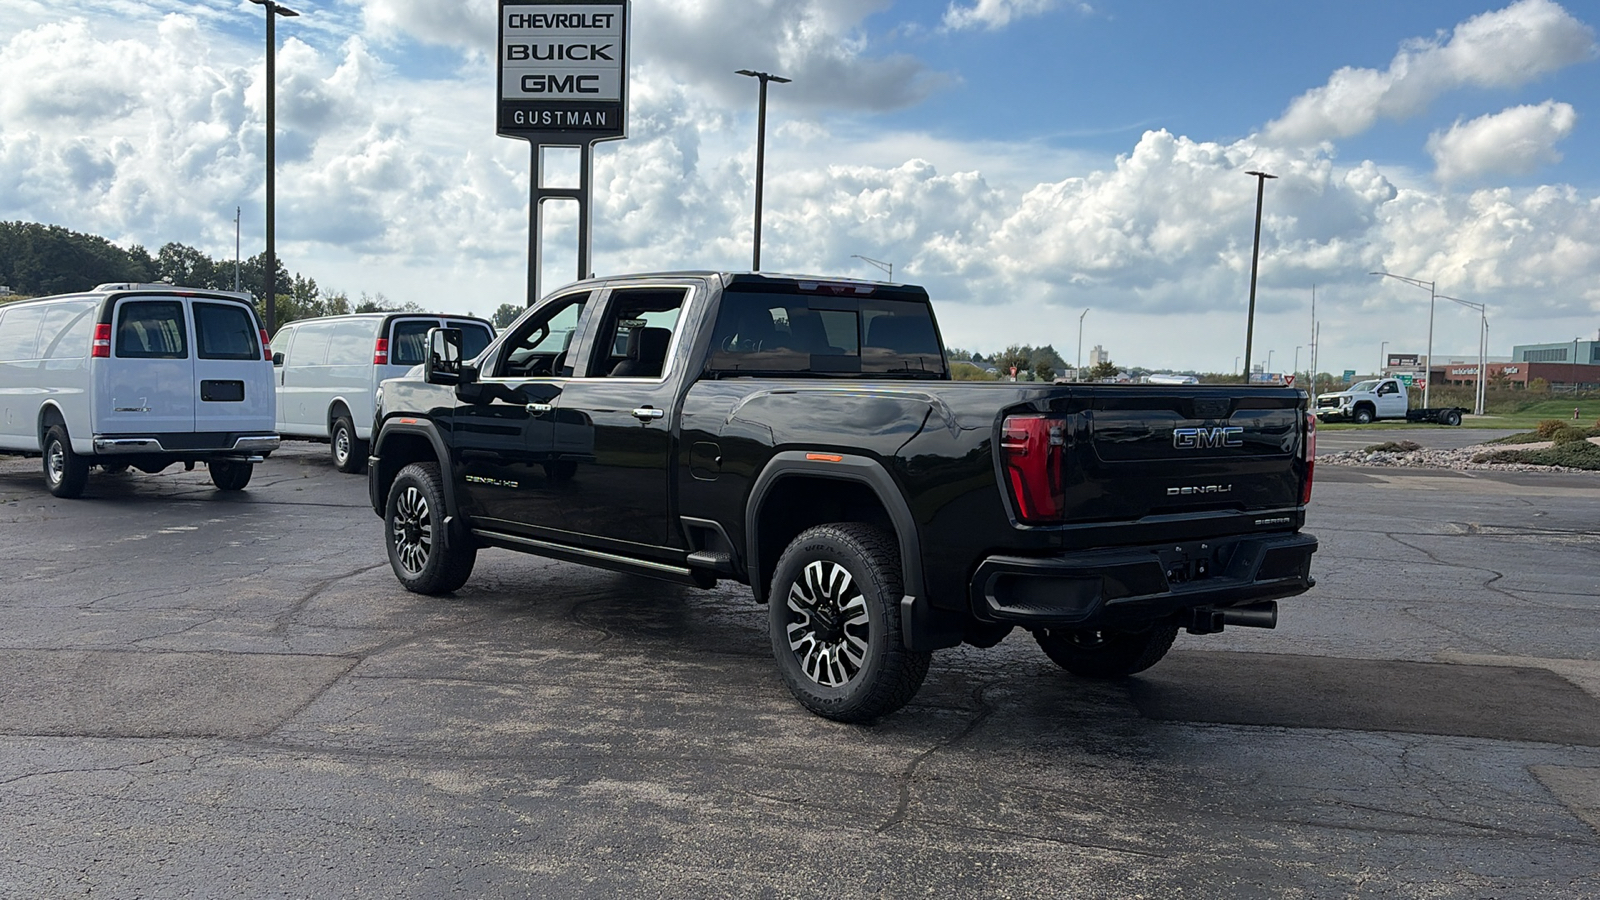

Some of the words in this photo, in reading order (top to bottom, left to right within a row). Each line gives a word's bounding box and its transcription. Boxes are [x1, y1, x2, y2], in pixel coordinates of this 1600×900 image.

[508, 13, 614, 29] CHEVROLET
[507, 44, 614, 61] BUICK
[520, 74, 599, 93] GMC
[513, 110, 606, 126] GUSTMAN
[1173, 427, 1243, 449] GMC
[465, 475, 502, 486] DENALI
[1166, 484, 1232, 496] DENALI
[1254, 517, 1290, 525] SIERRA
